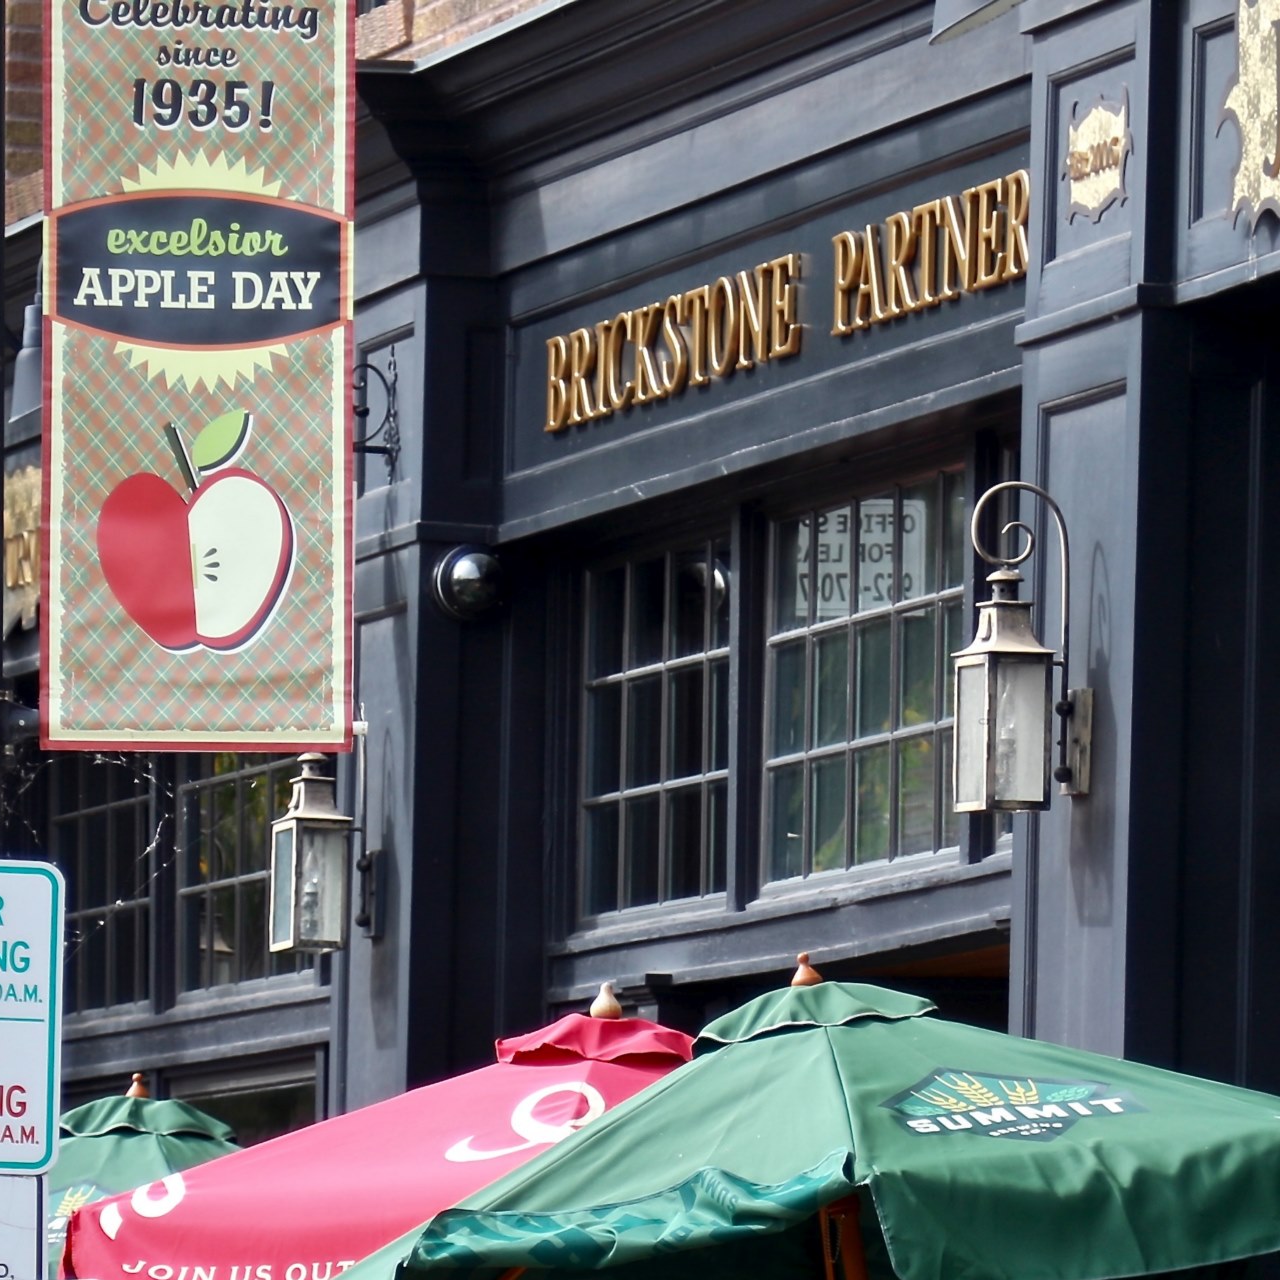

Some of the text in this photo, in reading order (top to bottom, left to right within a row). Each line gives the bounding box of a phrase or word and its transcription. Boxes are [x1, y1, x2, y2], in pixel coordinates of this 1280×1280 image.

[79, 0, 319, 43] Celebrating
[157, 40, 239, 68] since
[133, 78, 275, 132] 1935!
[107, 218, 289, 257] excelsior
[73, 267, 320, 310] APPLE DAY
[544, 168, 1030, 433] BRICKSTONE PARTNER
[906, 1097, 1125, 1134] SUMMIT
